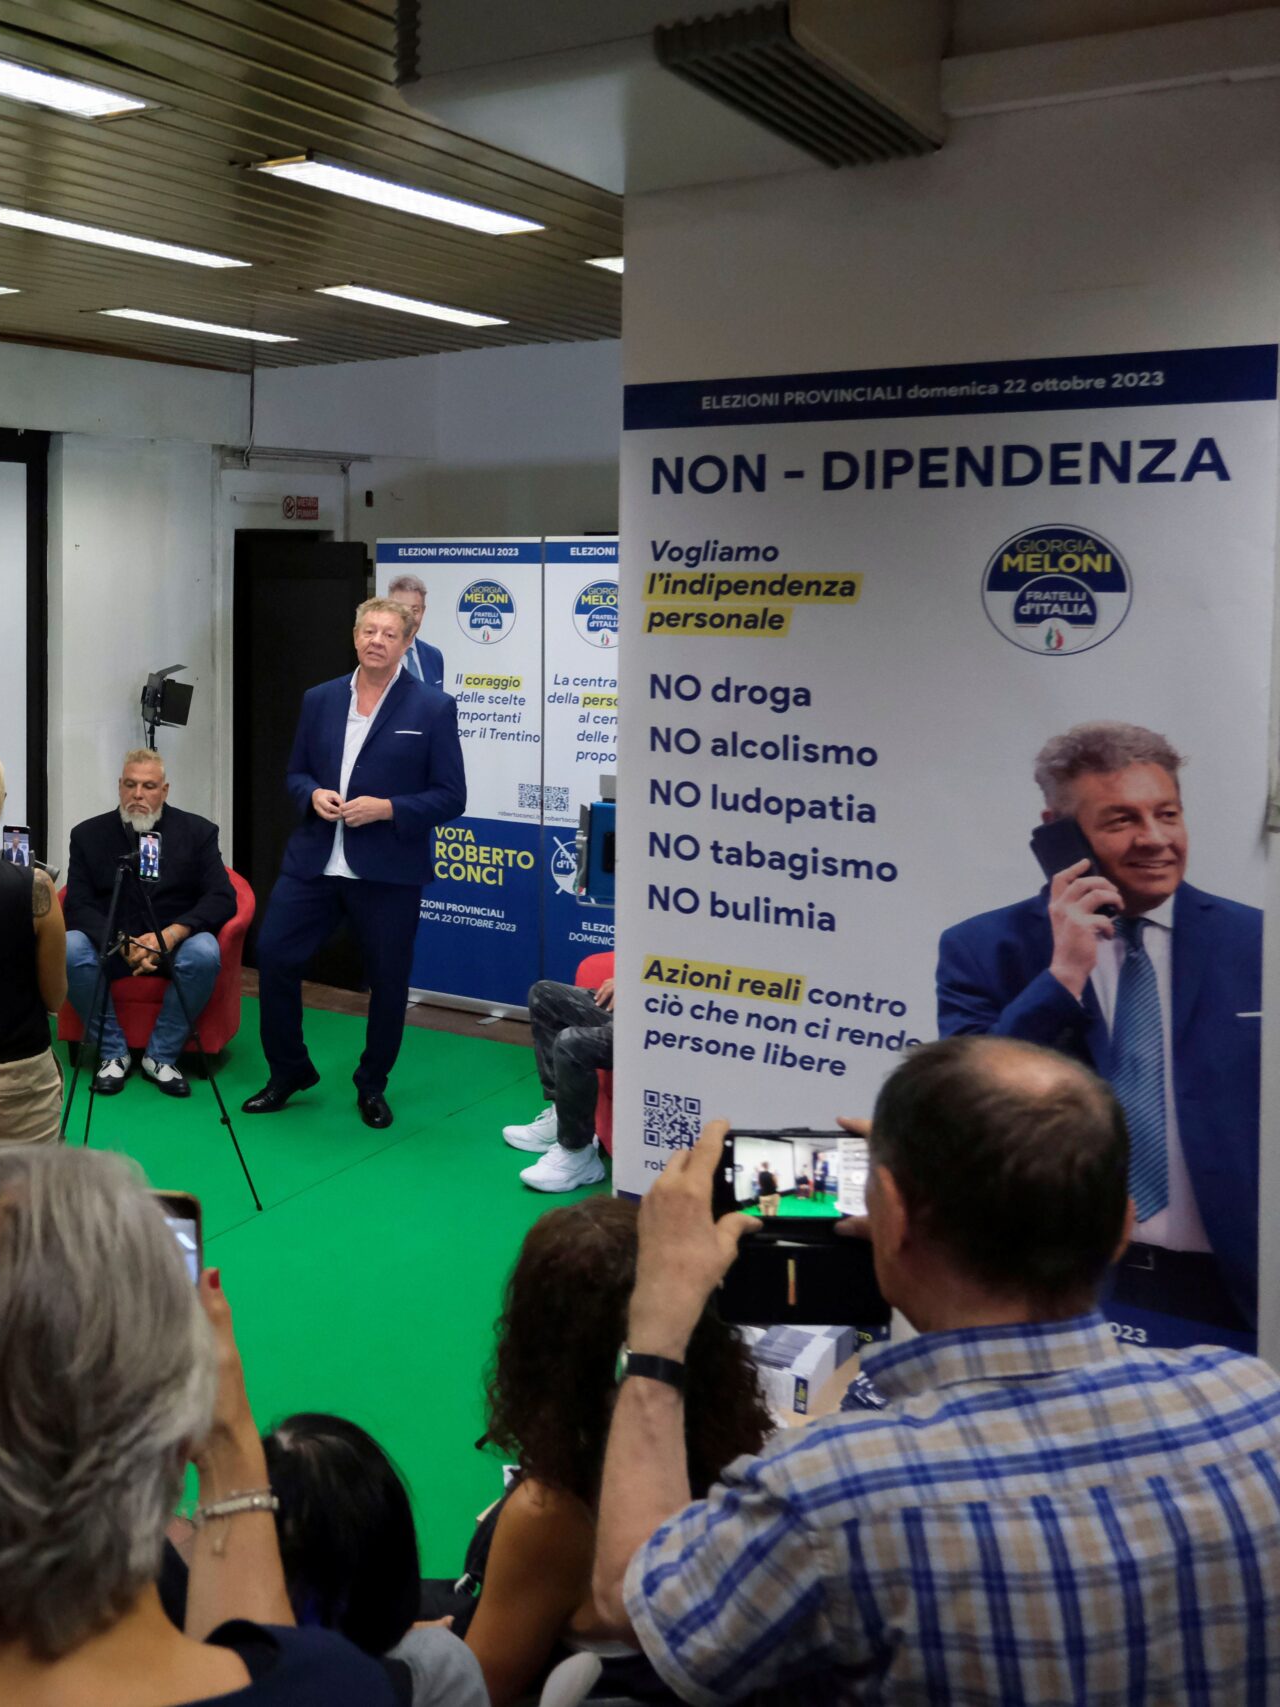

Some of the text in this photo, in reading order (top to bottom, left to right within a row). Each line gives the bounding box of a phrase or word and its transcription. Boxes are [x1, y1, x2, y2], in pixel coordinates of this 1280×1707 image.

[701, 370, 1165, 411] ELEZIONI PROVINCIALI domenica 22 ottobre 2023
[651, 437, 1231, 496] NON - DIPENDENZA
[398, 547, 519, 556] ELEZIONI PROVINCIALI 2023
[570, 547, 616, 556] ELEZIONI
[650, 538, 780, 567] Vogliamo
[1016, 539, 1097, 553] GIORGIA
[1002, 553, 1112, 573] MELONI
[470, 585, 502, 594] GIORGIA
[588, 587, 618, 595] GIORGI
[648, 573, 857, 602] l'indipendenza
[1026, 591, 1087, 601] FRATELLI
[464, 594, 509, 604] MELONI
[581, 595, 617, 605] MELO
[1020, 603, 1092, 616] d'ITALIA
[471, 617, 501, 625] d'ITALIA
[646, 606, 785, 634] personale
[455, 673, 521, 690] Il coraggio
[554, 674, 617, 688] La centra
[455, 691, 526, 706] delle scelte
[547, 692, 580, 705] della
[650, 673, 812, 714] NO droga
[457, 708, 522, 724] importanti
[578, 712, 618, 725] al cen
[479, 727, 486, 739] il
[489, 728, 541, 743] Trentino
[576, 730, 609, 744] delle
[650, 727, 879, 767] NO alcolismo
[576, 750, 617, 764] propo
[649, 778, 877, 824] NO ludopatia
[435, 826, 475, 843] VOTA
[435, 841, 535, 870] ROBERTO
[648, 832, 898, 883] NO tabagismo
[434, 861, 503, 886] CONCI
[420, 899, 505, 919] ZIONI PROVINCIALI
[648, 884, 837, 933] NO bulimia
[420, 910, 516, 933] NICA 22 OTTOBRE 2023
[582, 921, 615, 934] ELEZIO
[569, 931, 615, 946] DOMENIC
[644, 959, 907, 1017] Azioni reali contro
[644, 992, 684, 1018] ciò
[690, 999, 740, 1026] che
[745, 1010, 798, 1035] non
[804, 1017, 830, 1041] ci
[644, 1029, 847, 1077] persone libere
[1108, 1322, 1147, 1343] 023
